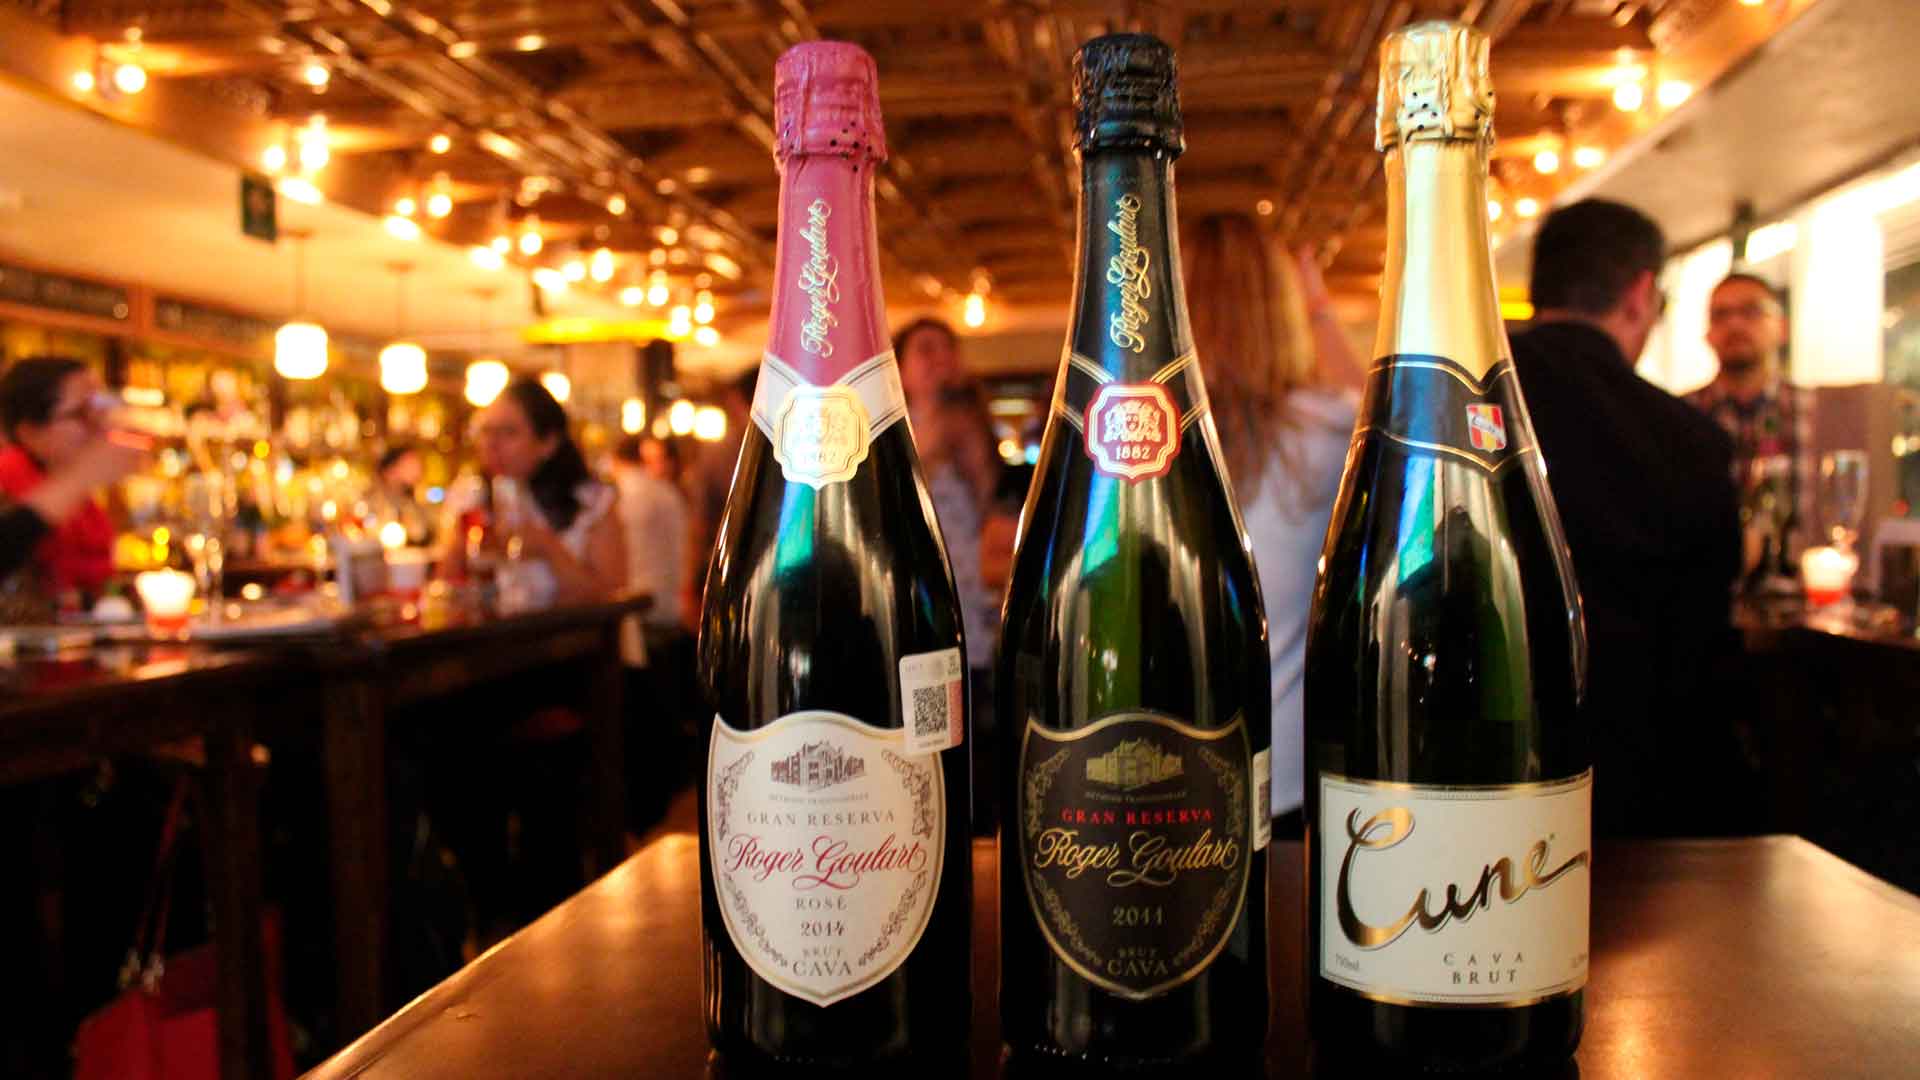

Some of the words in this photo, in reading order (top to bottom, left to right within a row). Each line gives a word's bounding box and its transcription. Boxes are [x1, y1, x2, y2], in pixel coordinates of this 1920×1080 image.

[799, 199, 840, 304] Goulart
[1107, 193, 1151, 299] Goulart
[801, 285, 838, 358] Roger
[1110, 282, 1149, 353] Roger
[1116, 446, 1151, 460] 1882
[747, 811, 796, 825] GRAN
[808, 811, 895, 826] RESERVA
[1062, 808, 1116, 825] GRAN
[1125, 808, 1214, 826] RESERVA
[724, 834, 804, 881] Roger
[792, 832, 927, 890] Goulart
[1034, 827, 1120, 879] Roger
[1106, 828, 1239, 887] Goulart
[796, 895, 847, 910] ROSÉ
[1112, 906, 1164, 926] 2011
[800, 920, 845, 937] 2014
[802, 946, 842, 959] BRUT
[1443, 951, 1525, 966] CAVA
[792, 961, 852, 977] CAVA
[1107, 959, 1169, 977] CAVA
[1452, 970, 1518, 984] BRUT
